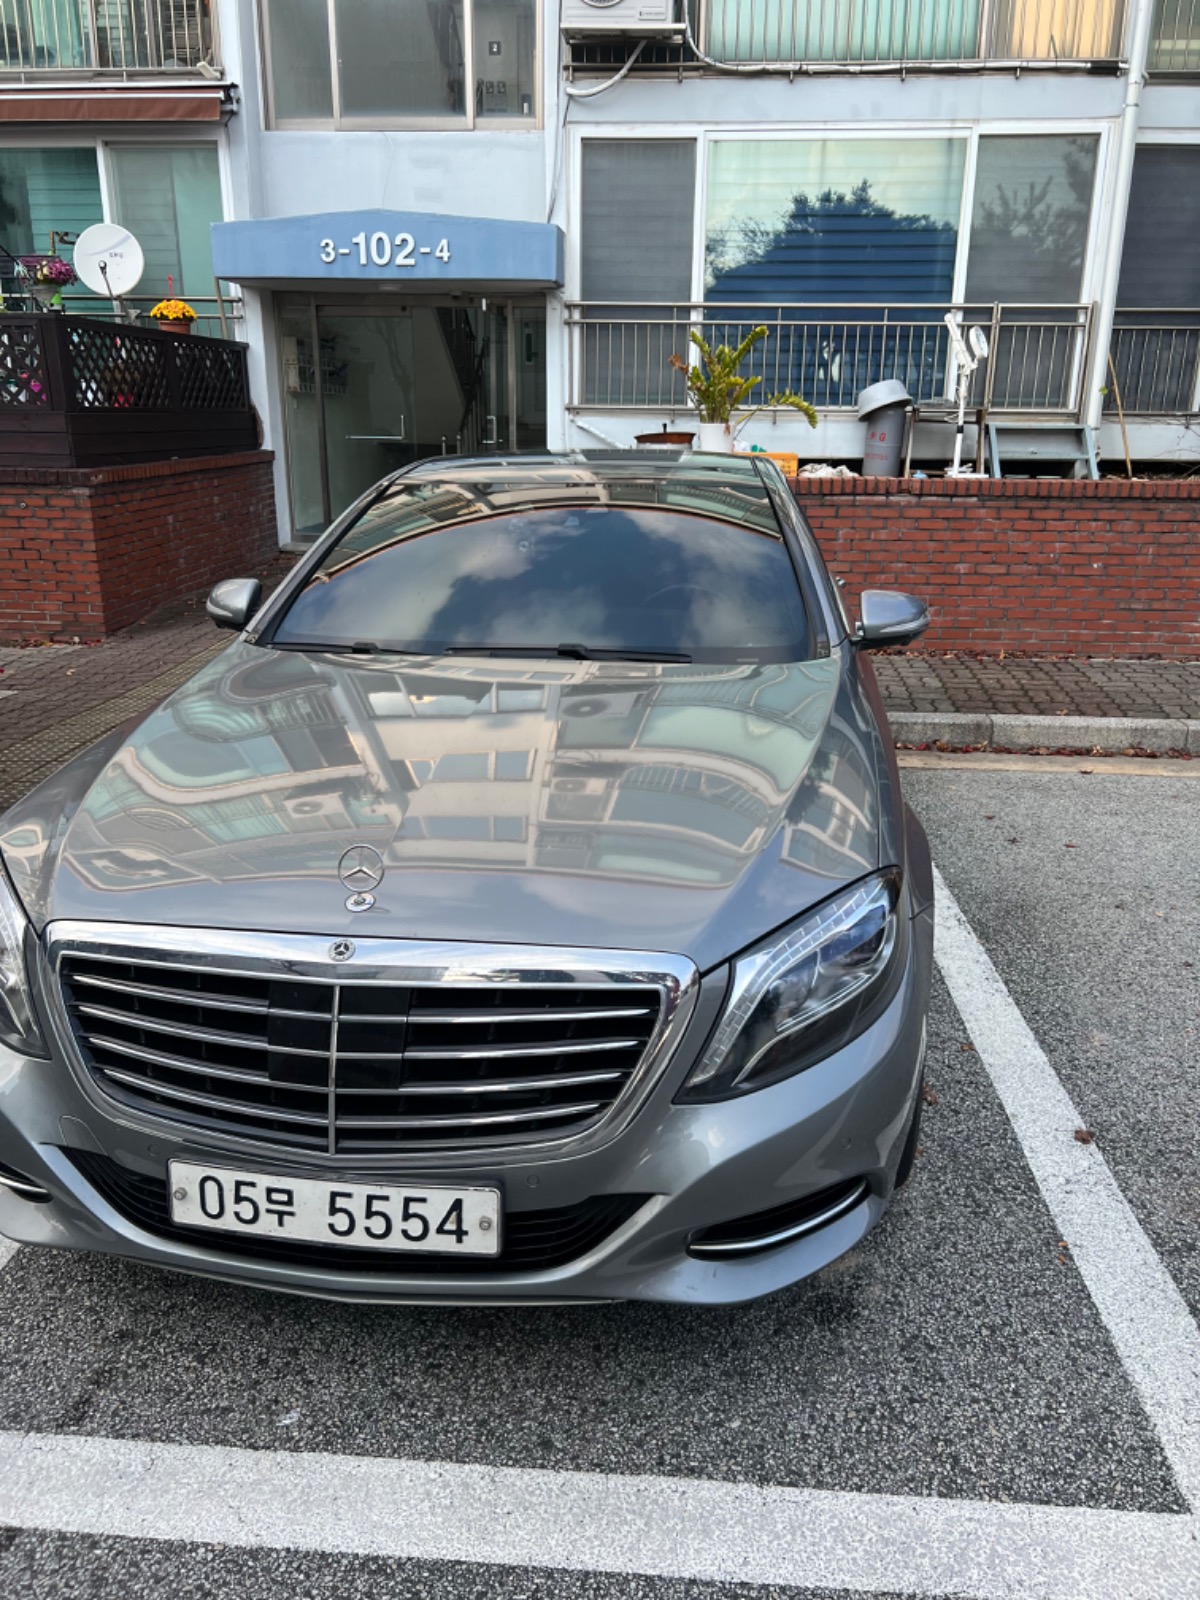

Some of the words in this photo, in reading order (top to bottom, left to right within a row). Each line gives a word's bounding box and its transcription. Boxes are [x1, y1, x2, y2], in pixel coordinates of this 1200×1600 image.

[320, 231, 451, 267] 3-102-4
[199, 1175, 296, 1227] 05무
[327, 1190, 469, 1243] 5554
